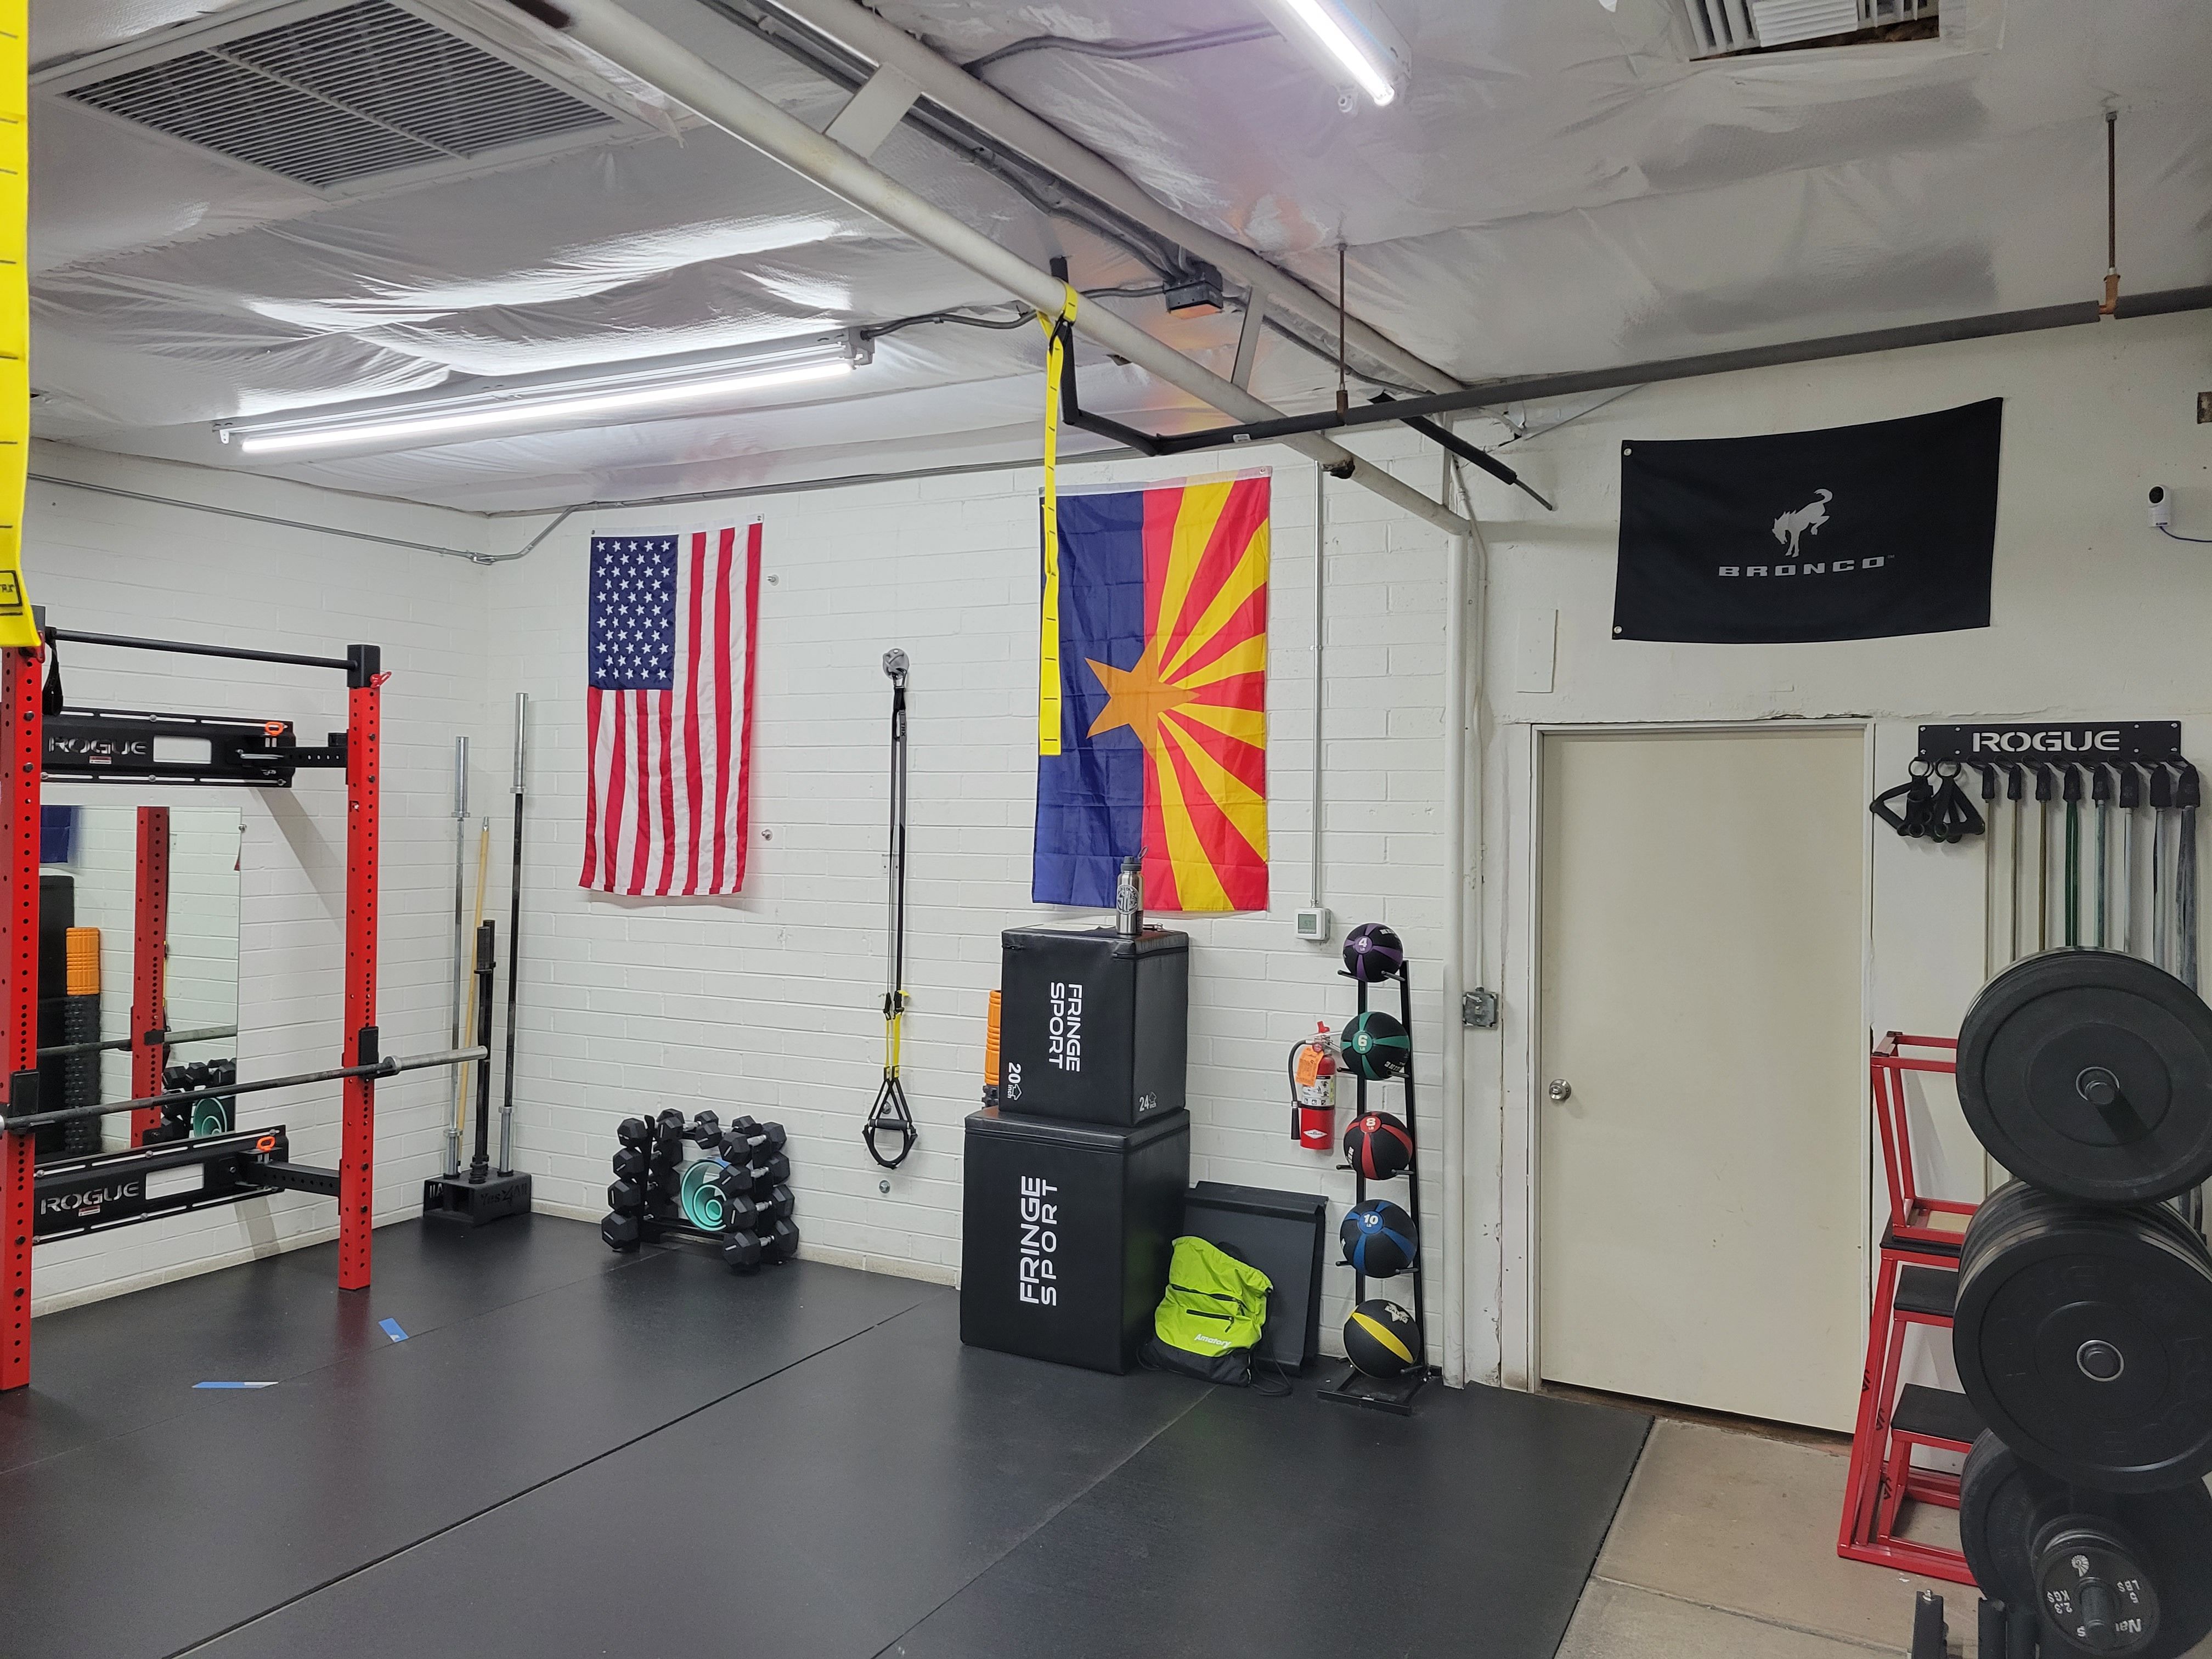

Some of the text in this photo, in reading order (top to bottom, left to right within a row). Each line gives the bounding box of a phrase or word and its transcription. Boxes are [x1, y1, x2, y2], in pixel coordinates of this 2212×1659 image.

[1718, 556, 1885, 577] BRONCO
[48, 736, 147, 755] ROGUE
[1972, 730, 2120, 752] ROGUE
[1358, 938, 1368, 947] 4
[1048, 982, 1065, 1069] SPORT
[1066, 984, 1083, 1072] FRINGE
[1358, 1035, 1368, 1047] 6
[1008, 1062, 1022, 1084] 20
[1139, 1094, 1149, 1112] 24
[1366, 1118, 1376, 1126] 8
[41, 1181, 139, 1215] ROGUE
[1364, 1214, 1379, 1225] 10
[1020, 1176, 1041, 1304] FRINGE
[1041, 1179, 1058, 1306] SPORT
[1194, 1333, 1232, 1348] Amatory
[2117, 1579, 2140, 1592] LBS
[2047, 1590, 2070, 1602] KGS
[2130, 1592, 2139, 1604] 5
[2054, 1602, 2073, 1614] 2.3
